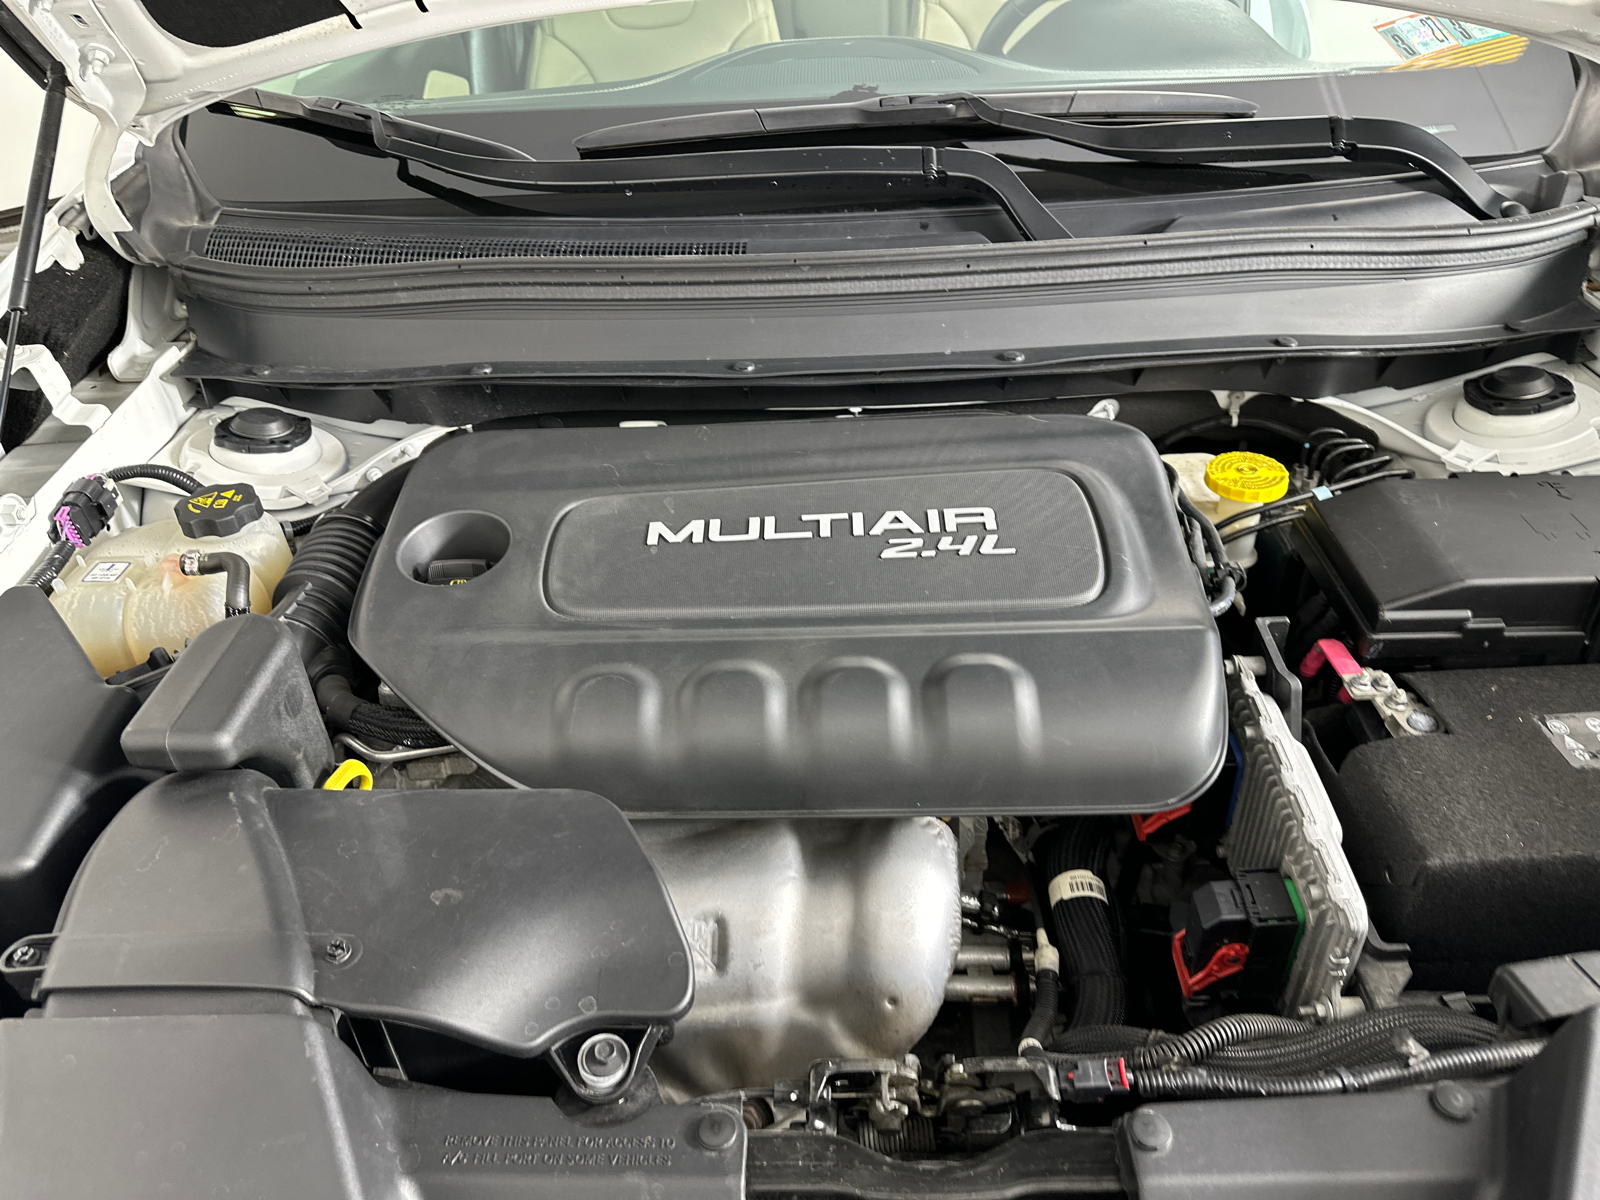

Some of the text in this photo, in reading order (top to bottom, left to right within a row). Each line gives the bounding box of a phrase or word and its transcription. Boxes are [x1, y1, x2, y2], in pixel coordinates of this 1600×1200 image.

[1391, 33, 1417, 56] 3
[646, 506, 998, 546] MULTIAIR
[879, 534, 1017, 560] 2.4L
[445, 1135, 676, 1149] REMOVE THIS PANEL FOR ACCESS TO
[442, 1150, 672, 1166] A/C FILL PORT ON SOME VEHICLES
